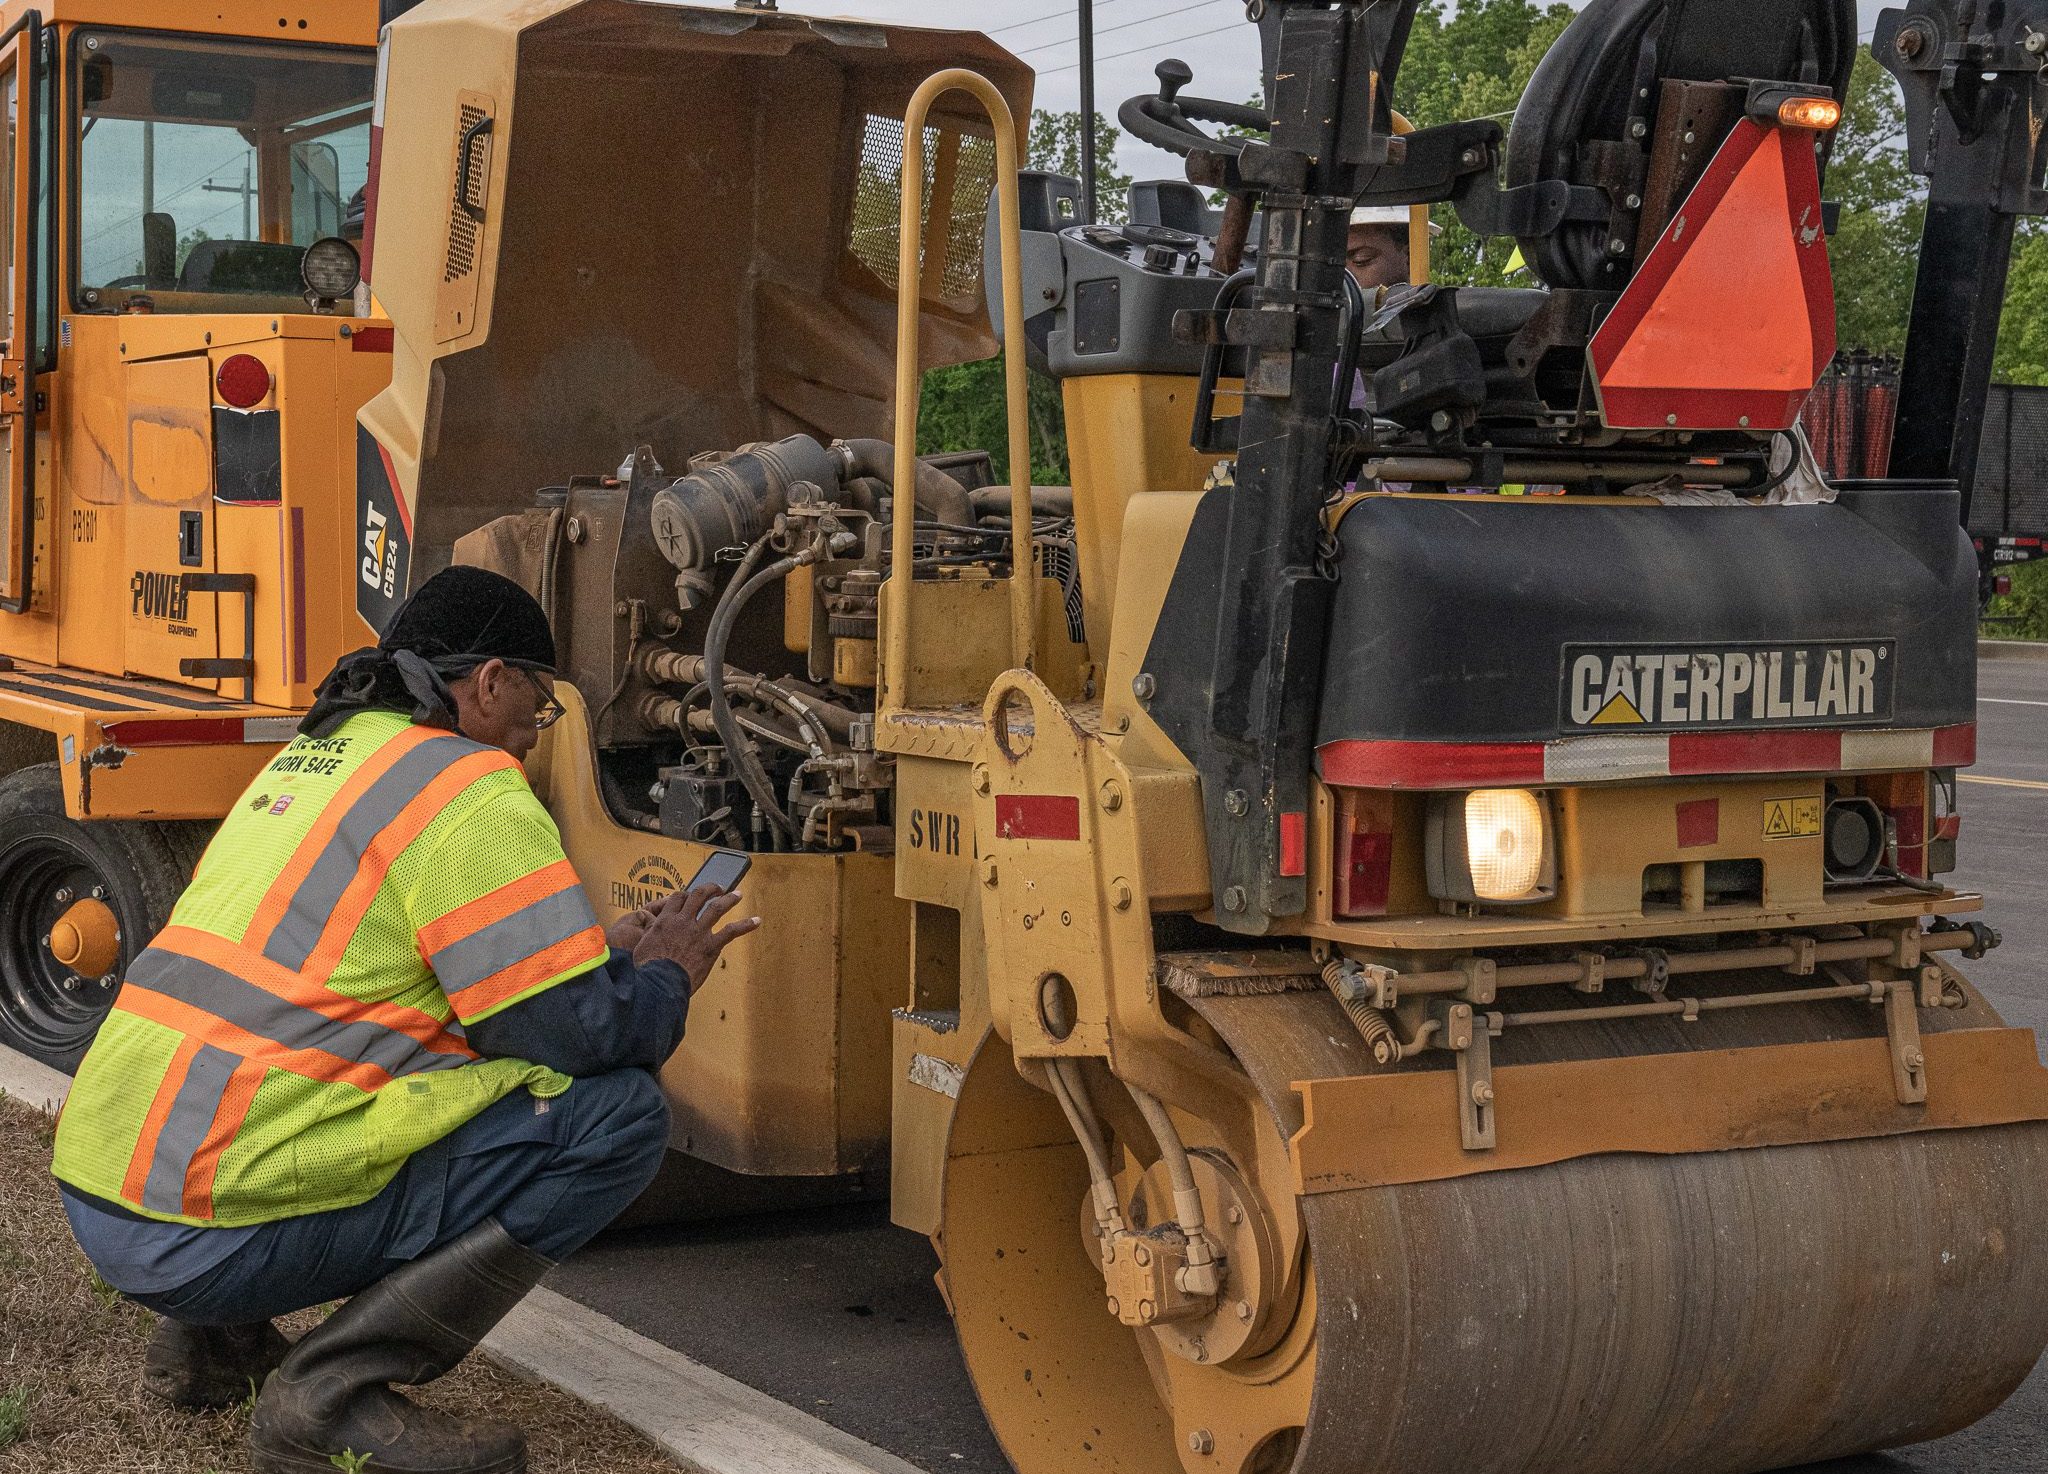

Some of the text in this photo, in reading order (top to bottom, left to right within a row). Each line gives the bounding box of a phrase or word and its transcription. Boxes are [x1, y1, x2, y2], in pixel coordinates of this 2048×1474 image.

[362, 499, 387, 590] CAT
[383, 539, 399, 599] CB24
[130, 570, 188, 623] POWER
[167, 623, 198, 638] EQUIPMENT
[1571, 648, 1876, 725] CATERPILLAR
[268, 755, 344, 776] WORK SAFE
[311, 737, 353, 754] SAFE
[910, 808, 960, 856] SWR
[628, 856, 647, 882] PAVING
